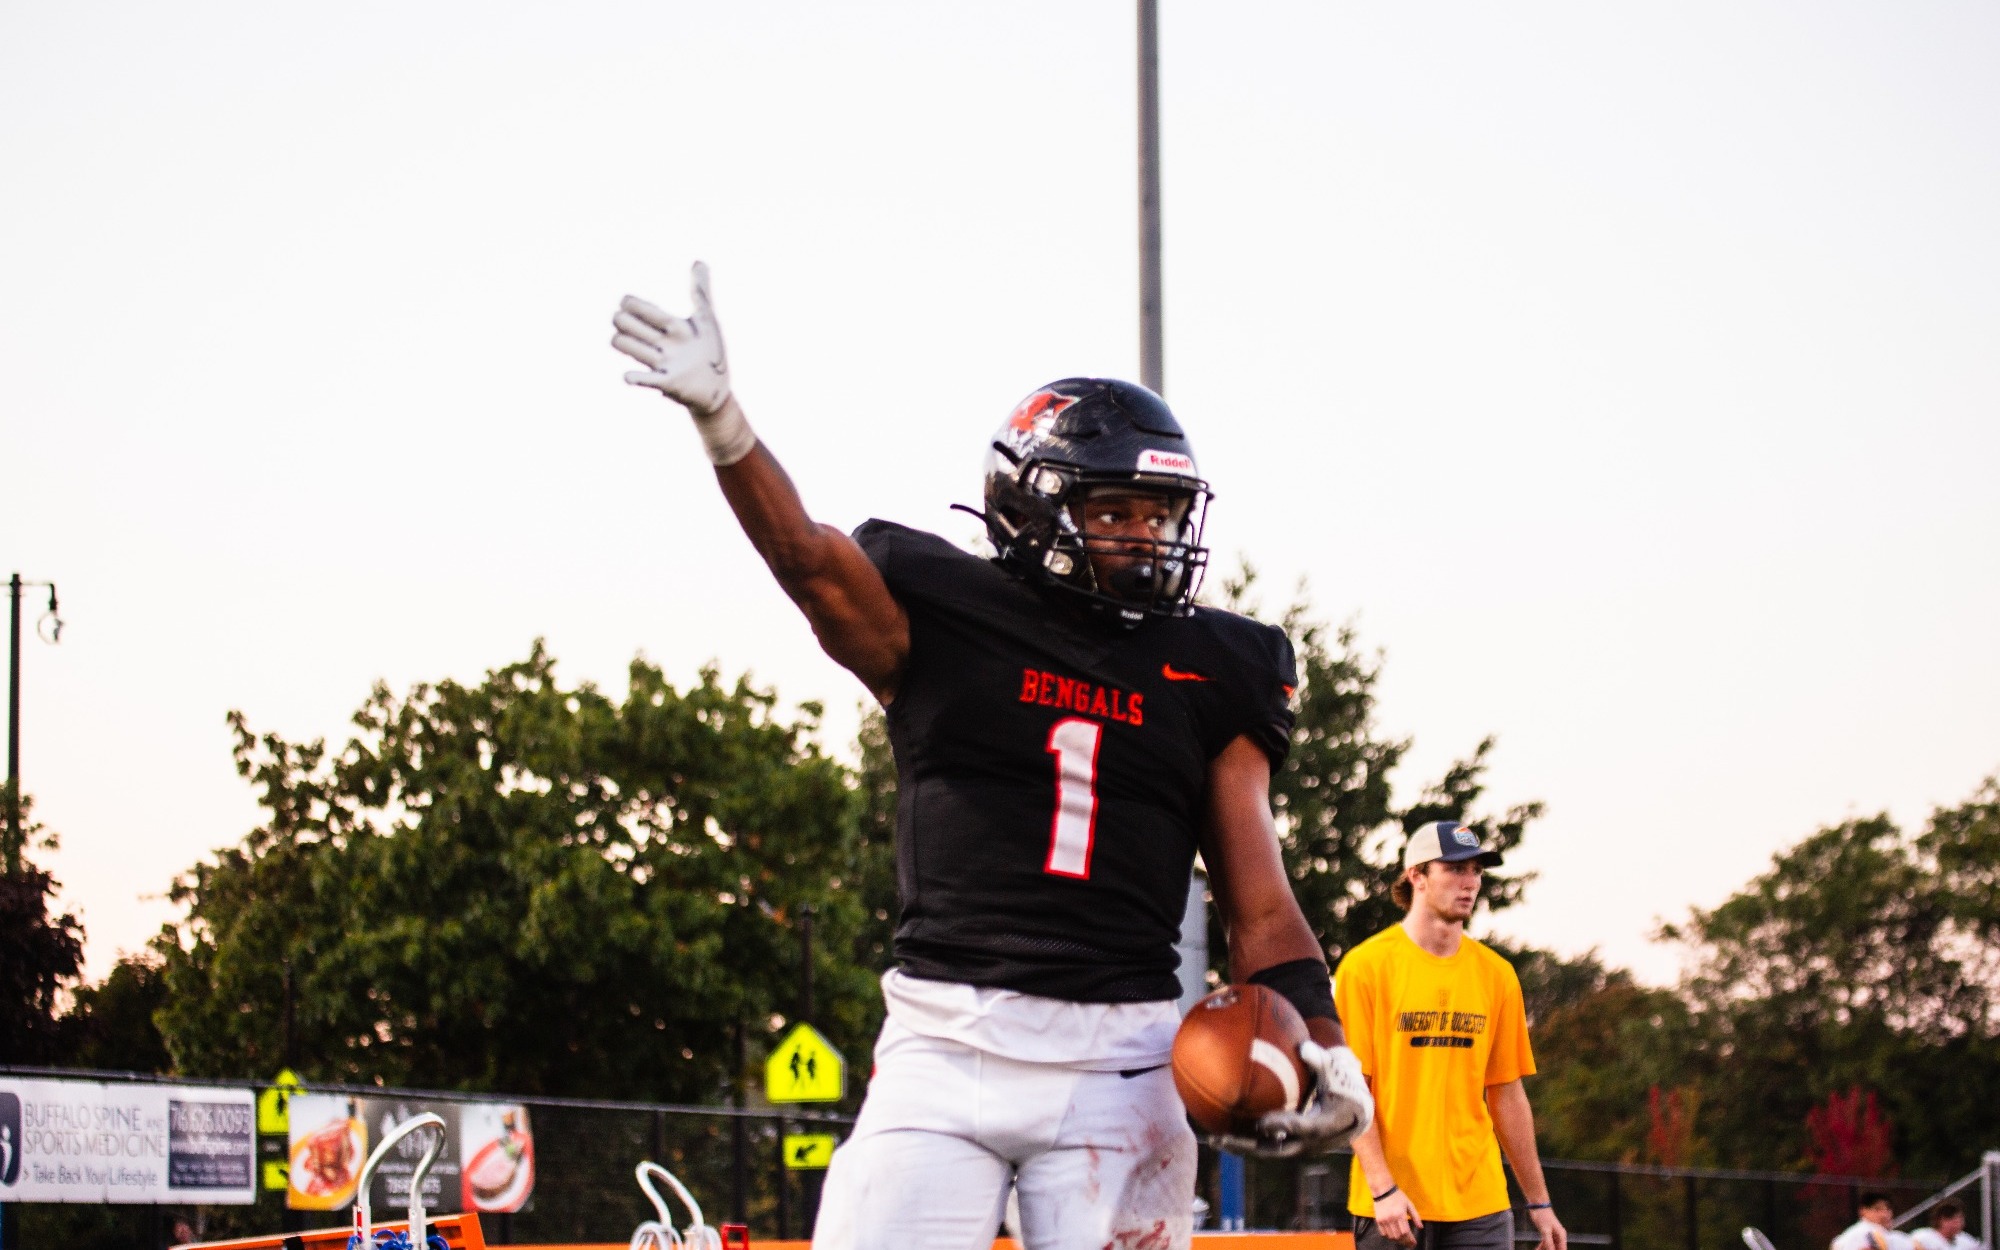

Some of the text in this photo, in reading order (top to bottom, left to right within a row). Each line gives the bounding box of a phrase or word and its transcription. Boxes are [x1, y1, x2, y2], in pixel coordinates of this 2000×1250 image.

[1019, 667, 1144, 726] BENGALS
[1043, 715, 1104, 880] 1
[1397, 1011, 1439, 1032] UNIVERSITY
[1440, 1011, 1450, 1031] OF
[24, 1103, 91, 1129] BUFFALO
[94, 1107, 142, 1131] SPINE
[24, 1130, 81, 1155] SPORTS
[84, 1133, 168, 1157] MEDICINE
[33, 1162, 56, 1184] Take
[58, 1164, 81, 1184] Back
[84, 1166, 108, 1185] Your
[108, 1167, 158, 1190] Lifestyle
